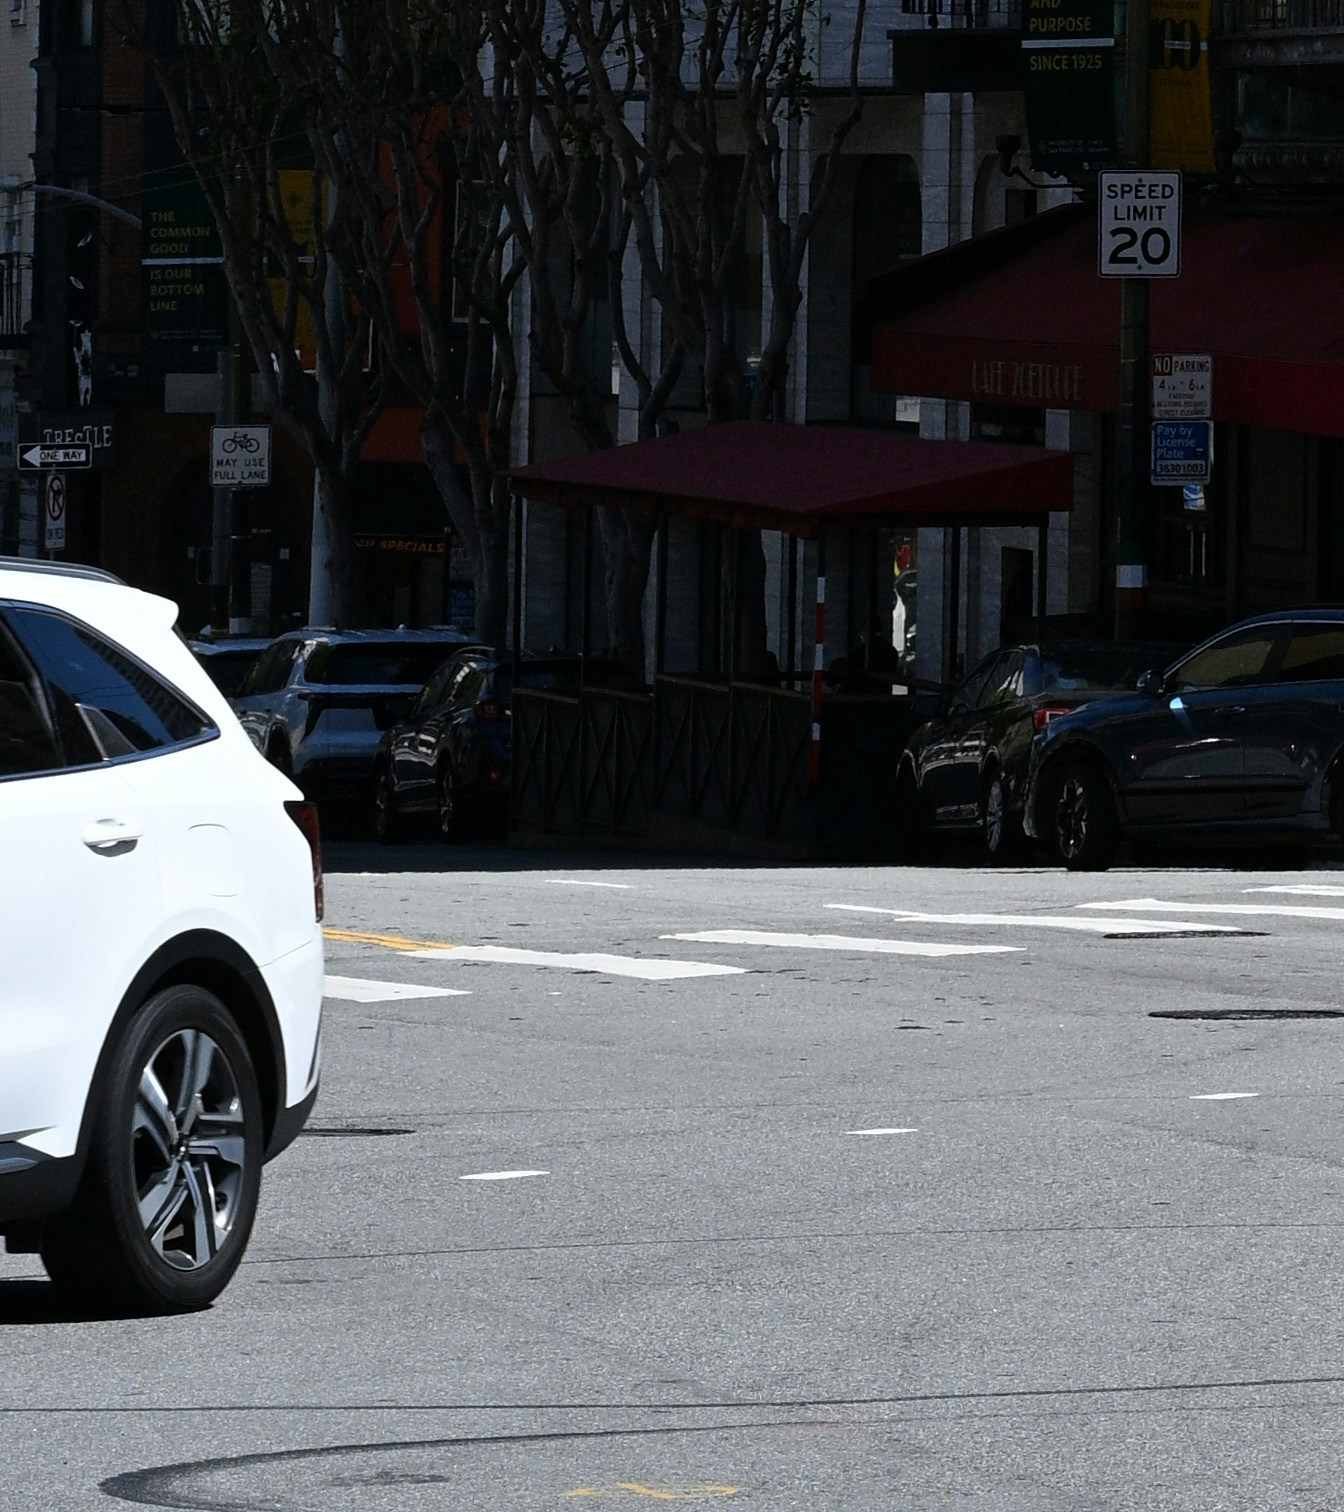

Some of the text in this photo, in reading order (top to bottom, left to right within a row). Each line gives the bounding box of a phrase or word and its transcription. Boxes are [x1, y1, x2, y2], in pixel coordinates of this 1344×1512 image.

[1029, 17, 1092, 33] PURPOSE
[1029, 54, 1103, 71] SINCE 1925
[1107, 184, 1174, 199] SPEED
[150, 211, 176, 223] THE
[1114, 205, 1166, 221] LIMIT
[150, 226, 211, 239] COMMON
[150, 242, 188, 255] GOOD
[1109, 227, 1170, 265] 20
[150, 268, 192, 280] IS OUR
[150, 284, 206, 297] BOTTOM
[150, 300, 178, 312] LINE
[1154, 356, 1210, 374] NO PARKING
[972, 358, 1083, 402] CAFE ZOETROPE
[1159, 379, 1166, 389] 4
[1188, 378, 1196, 391] 6
[1156, 424, 1194, 439] Pay by
[1156, 436, 1196, 448] License
[40, 450, 83, 461] ONE WAY
[1156, 447, 1184, 460] Plate
[216, 457, 265, 467] MAY USE
[214, 470, 266, 480] FULL LANE
[380, 539, 446, 554] SPECIALS
